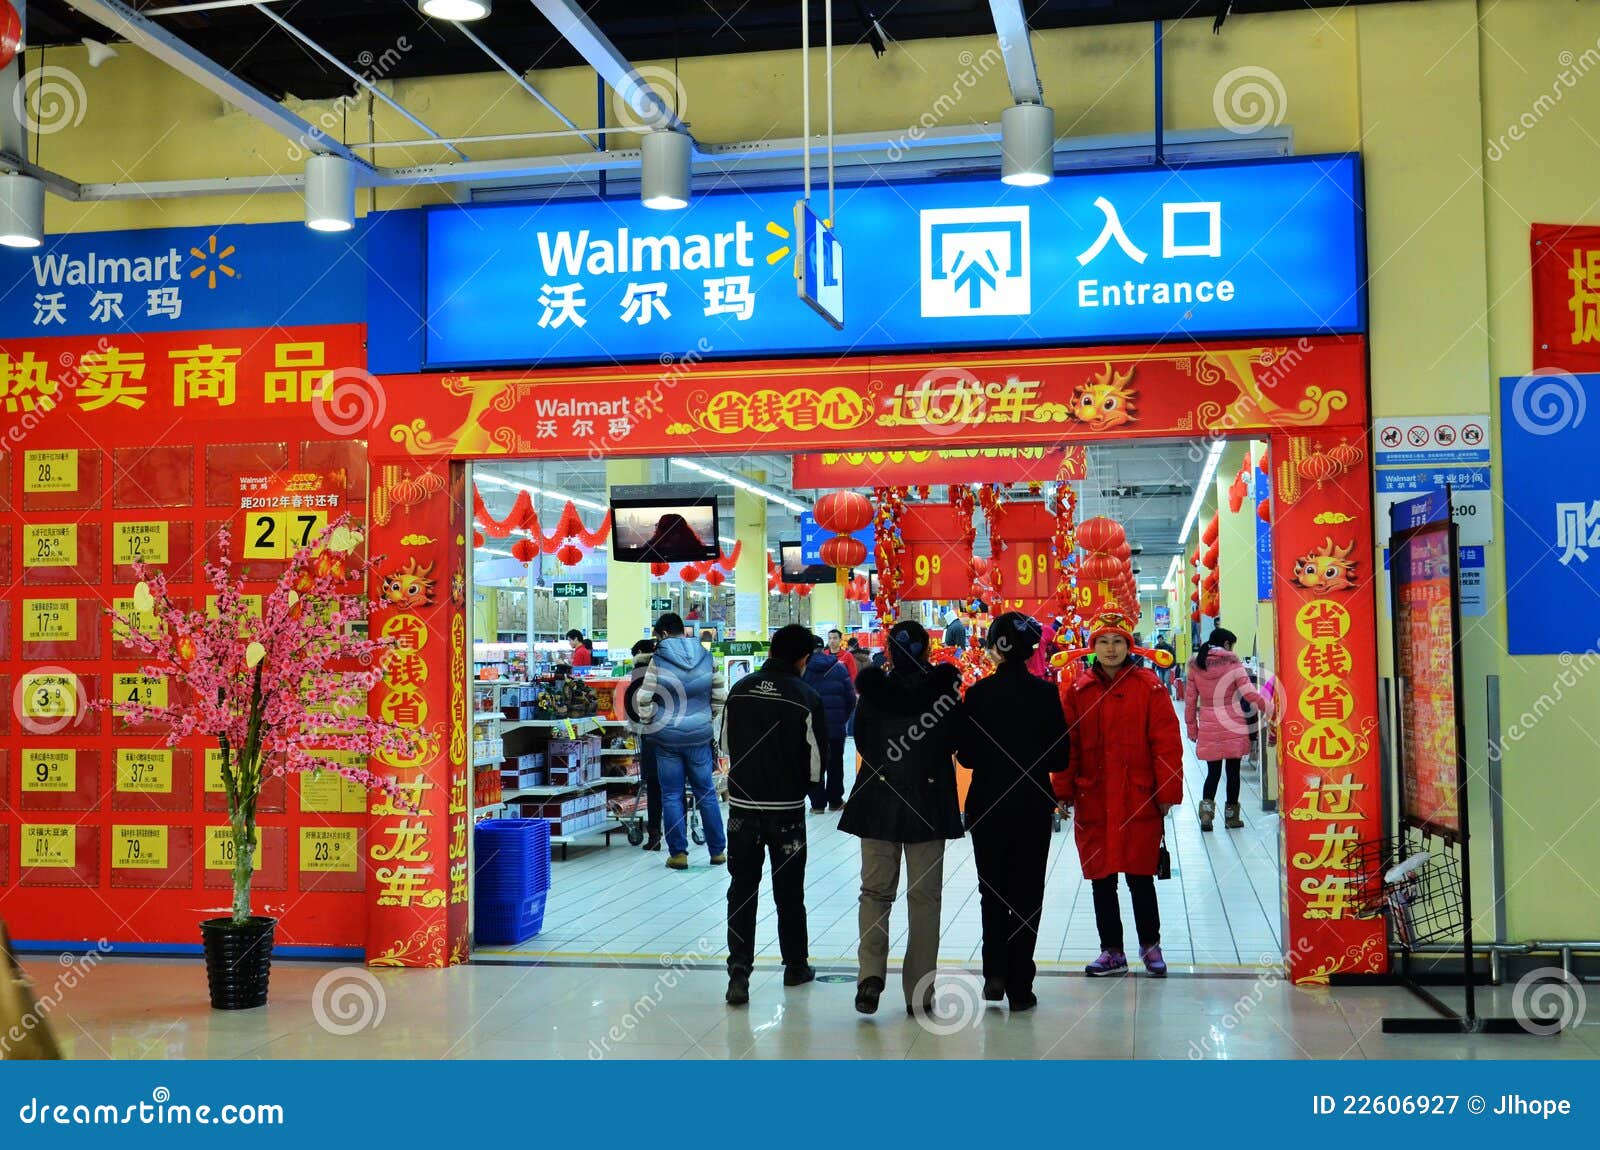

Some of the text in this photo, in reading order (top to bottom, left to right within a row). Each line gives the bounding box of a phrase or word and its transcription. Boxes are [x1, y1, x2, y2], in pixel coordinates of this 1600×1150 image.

[537, 220, 754, 276] Walmart
[1076, 196, 1222, 266] 入口
[32, 248, 182, 287] Walmart
[33, 287, 182, 326] 沃尔玛
[537, 275, 755, 329] 沃尔玛
[1077, 277, 1236, 308] Entrance
[0, 341, 335, 413] 热卖商品
[535, 395, 630, 417] Walmart
[708, 389, 862, 431] 省钱省心
[885, 379, 1042, 426] 过龙年
[536, 417, 632, 439] 沃尔玛
[38, 463, 51, 482] 28
[1385, 473, 1417, 482] Walmart
[241, 494, 339, 509] 距2012年春节还有
[450, 615, 465, 762] 省钱省心
[1302, 602, 1350, 762] 省钱省心
[127, 840, 140, 859] 79
[449, 772, 467, 905] 过龙年
[1291, 772, 1367, 920] 过龙年
